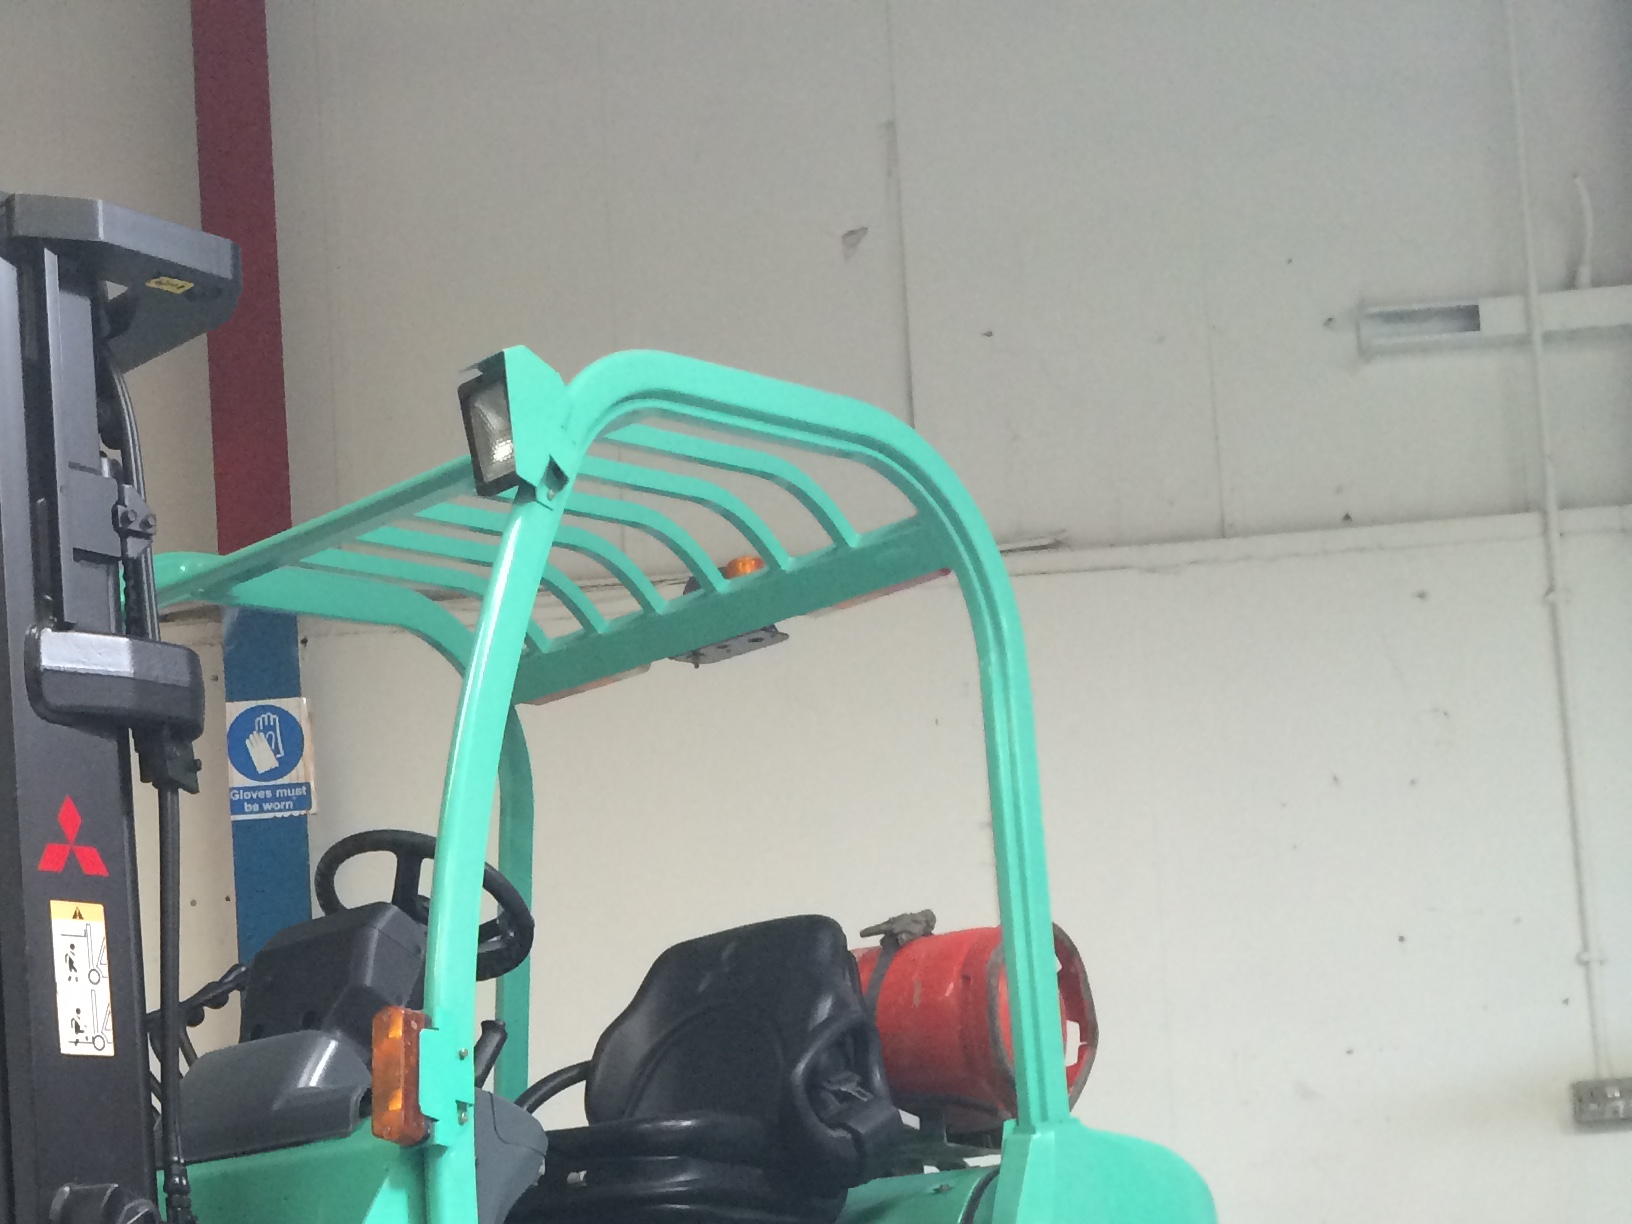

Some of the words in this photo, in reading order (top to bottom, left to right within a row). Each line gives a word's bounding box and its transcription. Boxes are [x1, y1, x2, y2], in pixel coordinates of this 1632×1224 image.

[230, 789, 272, 801] Gloves
[276, 786, 307, 798] must
[244, 802, 260, 812] be
[262, 801, 294, 811] worn
